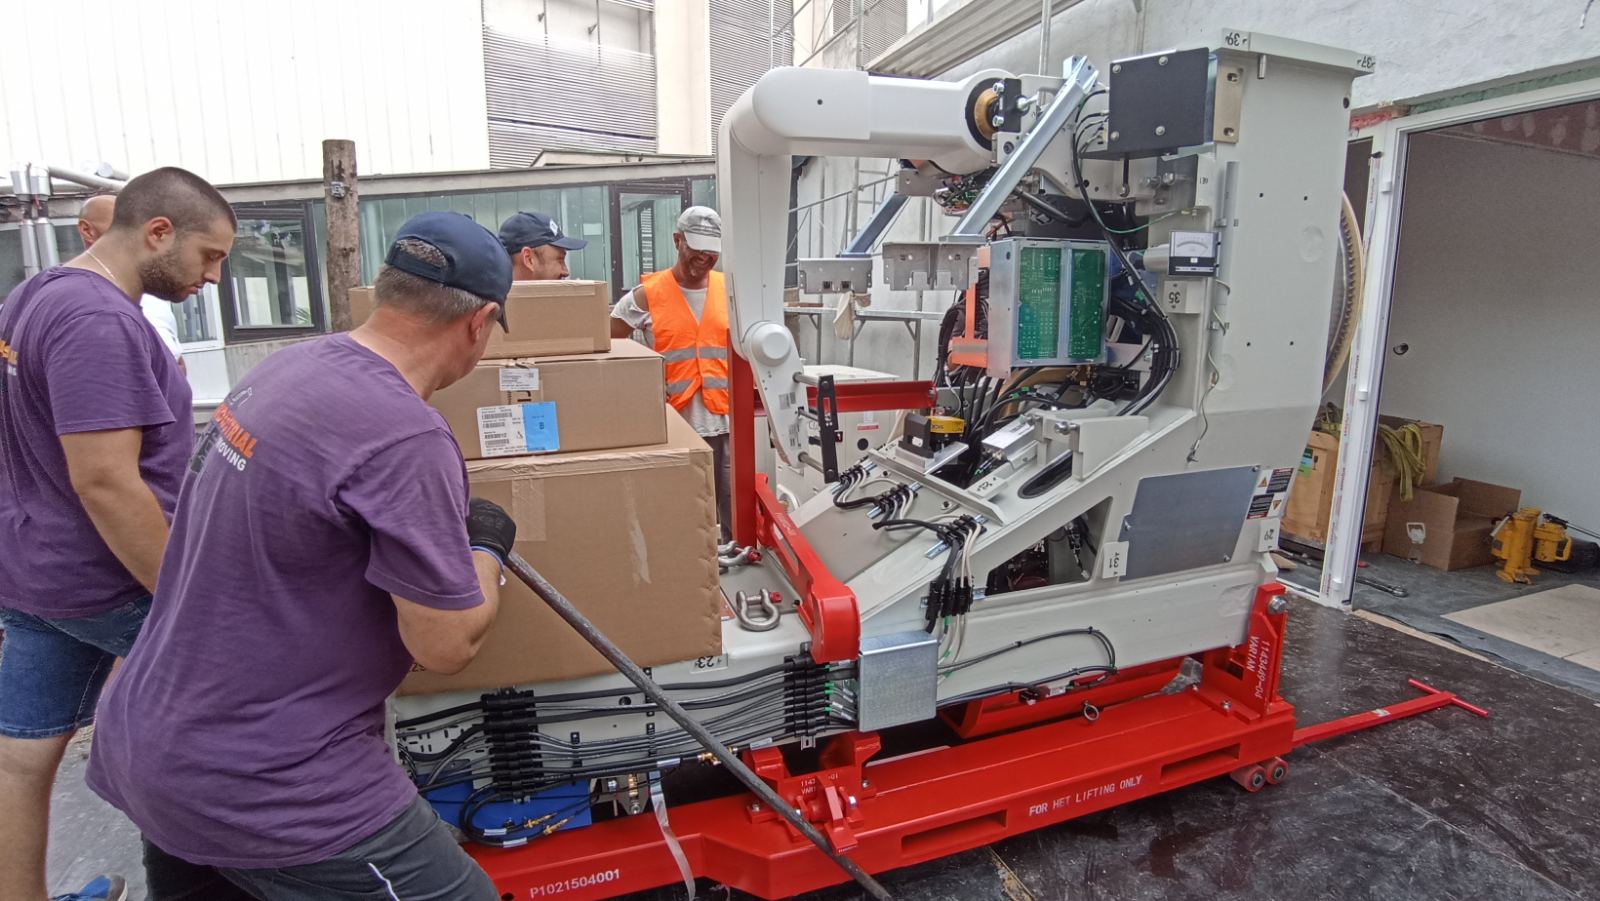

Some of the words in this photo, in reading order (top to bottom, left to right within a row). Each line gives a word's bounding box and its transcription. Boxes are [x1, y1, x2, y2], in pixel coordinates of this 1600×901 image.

[1168, 291, 1181, 304] 35
[697, 655, 715, 668] 23
[1246, 635, 1260, 672] VARIAN
[1028, 802, 1048, 816] FOR
[1075, 783, 1115, 803] LIFTING
[1120, 774, 1143, 790] ONLY
[530, 868, 620, 899] P1021504001
